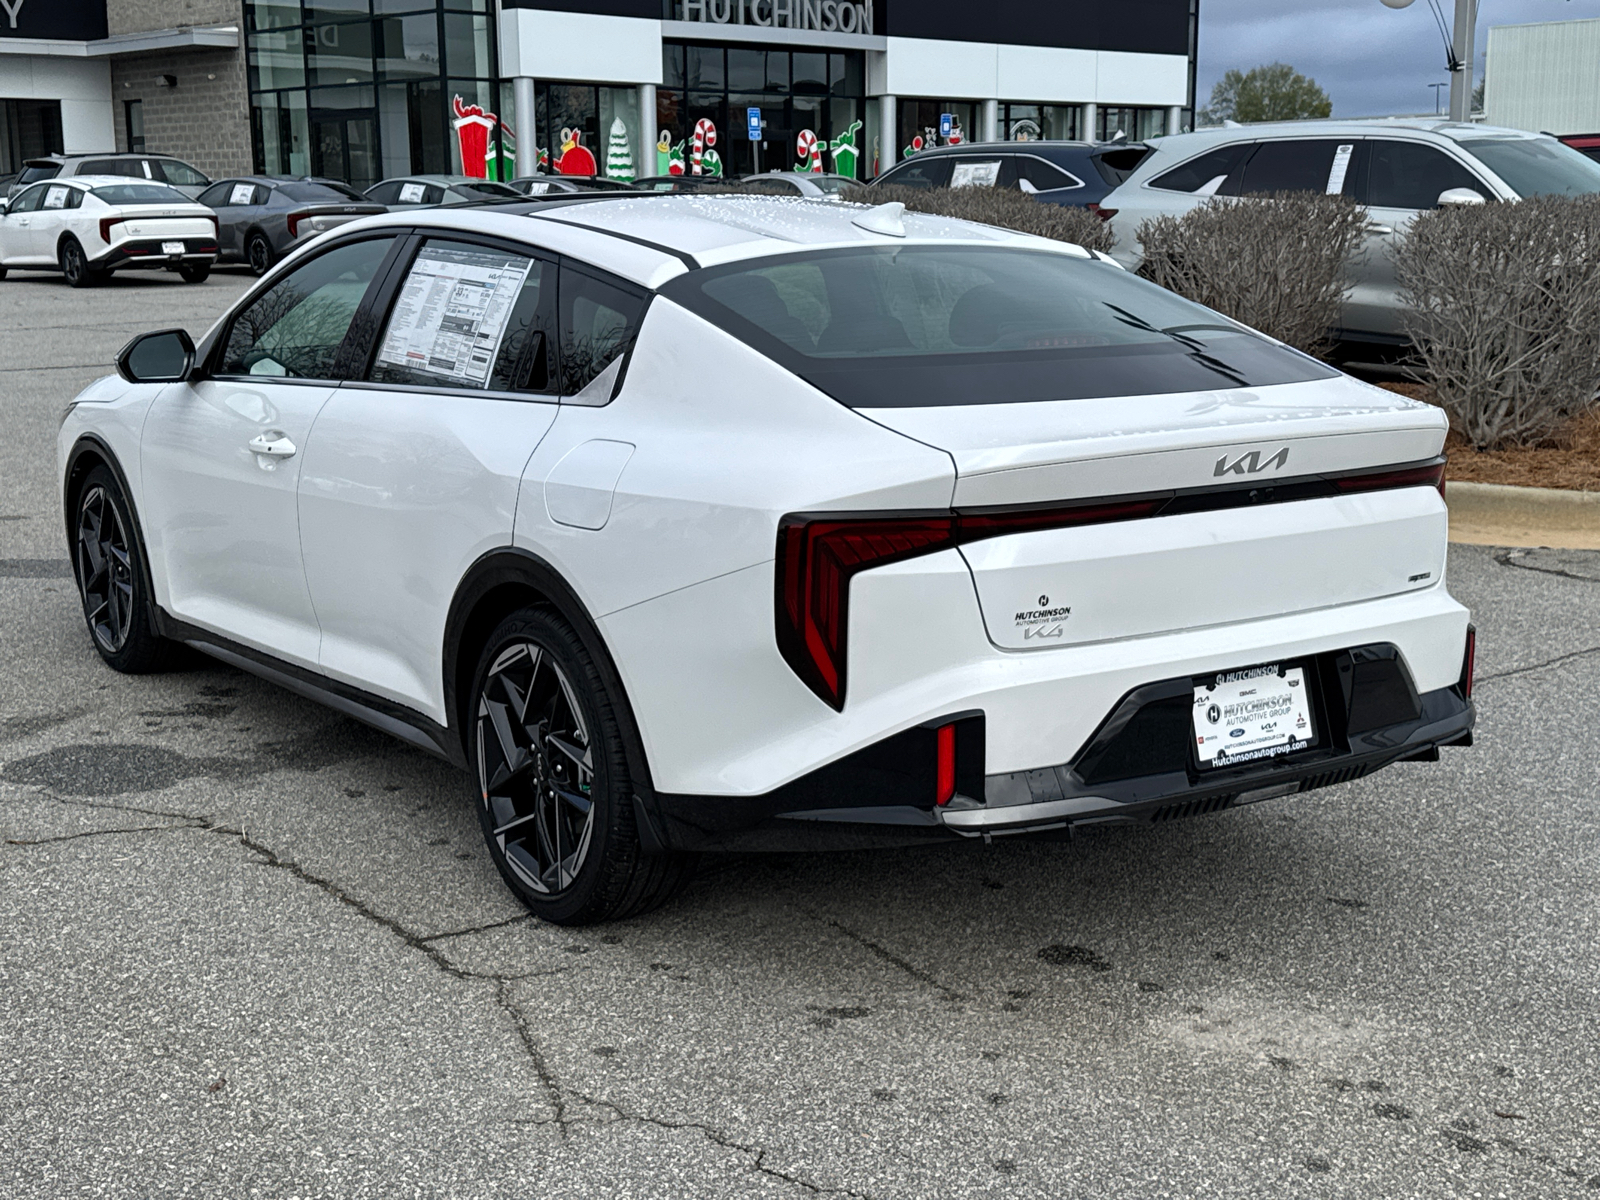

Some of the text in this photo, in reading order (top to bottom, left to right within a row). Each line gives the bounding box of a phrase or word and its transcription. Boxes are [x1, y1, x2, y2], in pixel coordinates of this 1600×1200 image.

[682, 0, 874, 35] HUTCHINSON
[1213, 446, 1290, 477] KIA
[1015, 607, 1071, 621] HUTCHINSON
[1015, 615, 1069, 626] AUTOMOTIVE GROUP
[1024, 623, 1063, 640] K4
[1226, 664, 1279, 683] HUTCHINSON
[1239, 688, 1257, 697] GMC
[1224, 692, 1293, 718] HUTCHINSON
[1226, 706, 1291, 726] AUTOMOTIVE GROUP
[1230, 729, 1244, 737] Ford
[1211, 740, 1308, 767] Hutchinsonautogroup.com
